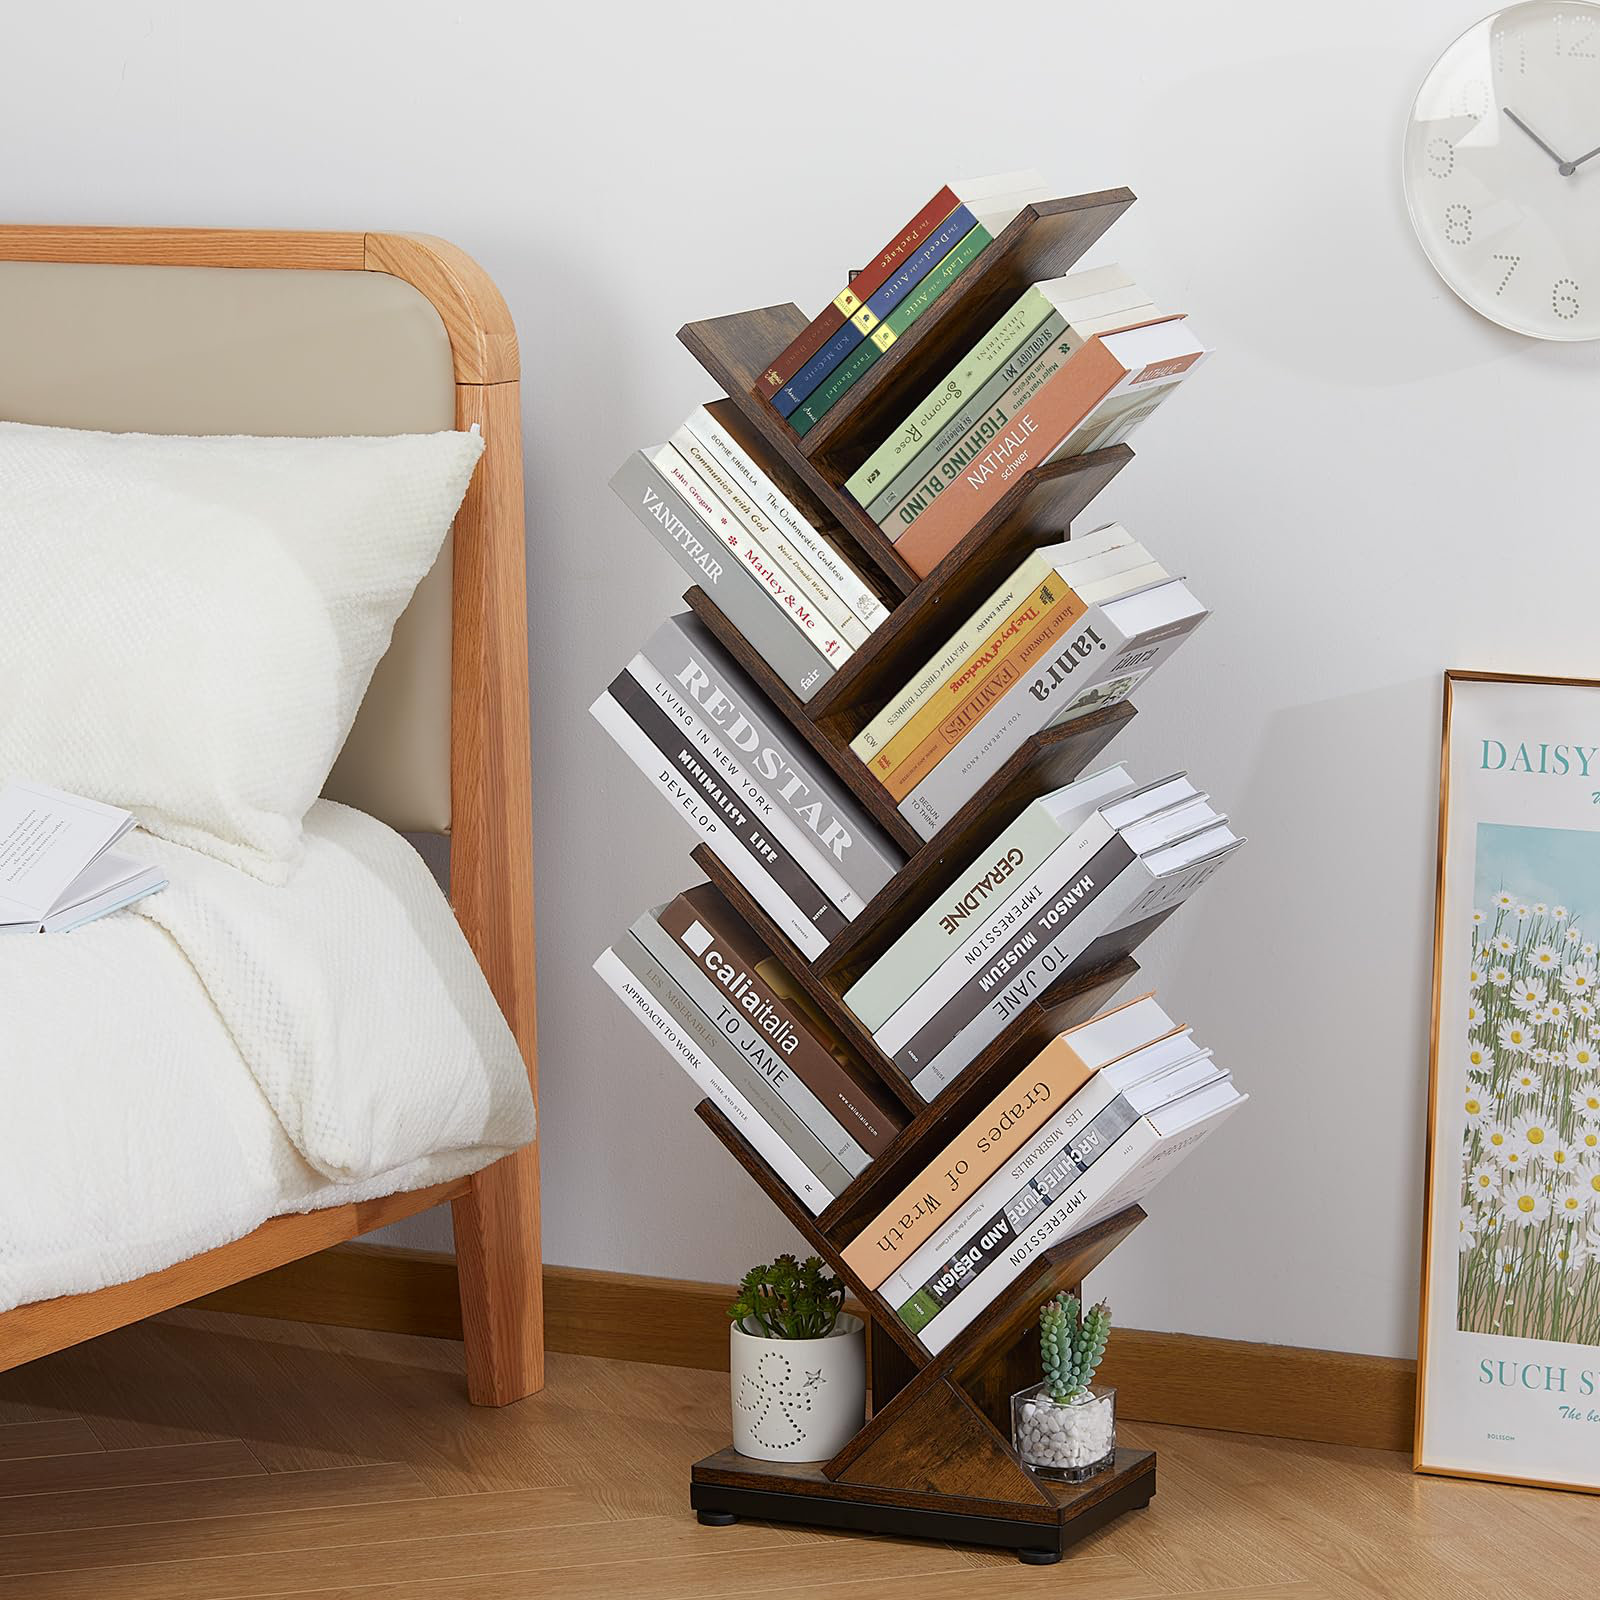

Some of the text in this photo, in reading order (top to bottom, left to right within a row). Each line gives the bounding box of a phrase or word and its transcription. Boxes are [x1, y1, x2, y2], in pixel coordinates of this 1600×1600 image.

[1427, 138, 1455, 179] 9
[922, 232, 949, 260] Deed
[1445, 203, 1473, 246] 8
[877, 227, 919, 270] Package
[939, 254, 963, 279] Lady
[882, 272, 910, 301] Attic
[1493, 254, 1521, 297] 7
[904, 291, 929, 317] Attic
[1552, 277, 1580, 320] 6
[974, 309, 1025, 360] CHIAVERINI
[985, 321, 1025, 361] JENNIFER
[852, 351, 871, 371] Tara
[1010, 360, 1047, 397] Jim DeFelice
[824, 370, 852, 399] Randel
[914, 380, 964, 430] Sonoma
[1011, 390, 1032, 411] Castro
[1028, 377, 1044, 393] Ivan
[889, 423, 923, 458] Rose
[938, 407, 1010, 481] FIGHTING
[964, 413, 1041, 490] NATHALIE
[997, 447, 1031, 481] schwer
[670, 466, 714, 515] John Grogan
[689, 445, 770, 534] Communion with God
[764, 491, 782, 511] The
[896, 474, 946, 525] BLIND
[636, 485, 728, 585] VANITYFAIR
[776, 542, 794, 562] Neale
[791, 559, 813, 582] Donald
[741, 548, 818, 630] Marley & Me
[974, 591, 1015, 633] ANNE EMERY
[1050, 604, 1075, 630] Jane
[943, 640, 969, 666] DEATH
[947, 603, 1040, 696] The Joy of Working
[1018, 626, 1055, 662] Howard
[796, 666, 822, 691] fair
[911, 668, 942, 699] CHRISTY
[1025, 624, 1110, 709] ianra
[941, 666, 1015, 740] FAMILIES
[653, 682, 774, 815] LIVING IN NEW YORK
[670, 655, 861, 863] REDSTAR
[862, 731, 879, 748] ECW
[959, 710, 1022, 775] YOU ALREADY KNOW
[1479, 738, 1600, 778] DAISY
[657, 769, 718, 835] DEVELOP
[675, 748, 779, 864] MINIMALIST LIFE
[910, 798, 922, 811] TO
[916, 808, 938, 829] THINK
[917, 795, 941, 819] BEGUN
[937, 845, 1027, 936] GERALDINE
[962, 884, 1043, 965] IMPERESSION
[976, 874, 1095, 993] HANSOL MUSEUM
[700, 944, 806, 1055] caliaitalia
[990, 943, 1068, 1021] TO JANE
[620, 981, 702, 1070] APPROACH TO WORK
[644, 968, 720, 1049] LES MISERABLES
[711, 1004, 742, 1036] TO
[737, 1033, 790, 1088] JANE
[708, 1078, 749, 1123] HOME AND STYLE
[836, 1091, 879, 1137] www.caliaitalia.com
[1009, 1107, 1084, 1181] LES MISERABLES
[803, 1183, 813, 1193] R
[874, 1076, 1054, 1257] Grapes of Wrath
[1004, 1129, 1102, 1226] ARCHITECTURE
[977, 1217, 1012, 1252] AND
[1007, 1187, 1088, 1268] IMPERESSION
[930, 1244, 984, 1298] DESIGN
[1478, 1358, 1569, 1393] SUCH
[1558, 1405, 1583, 1421] The
